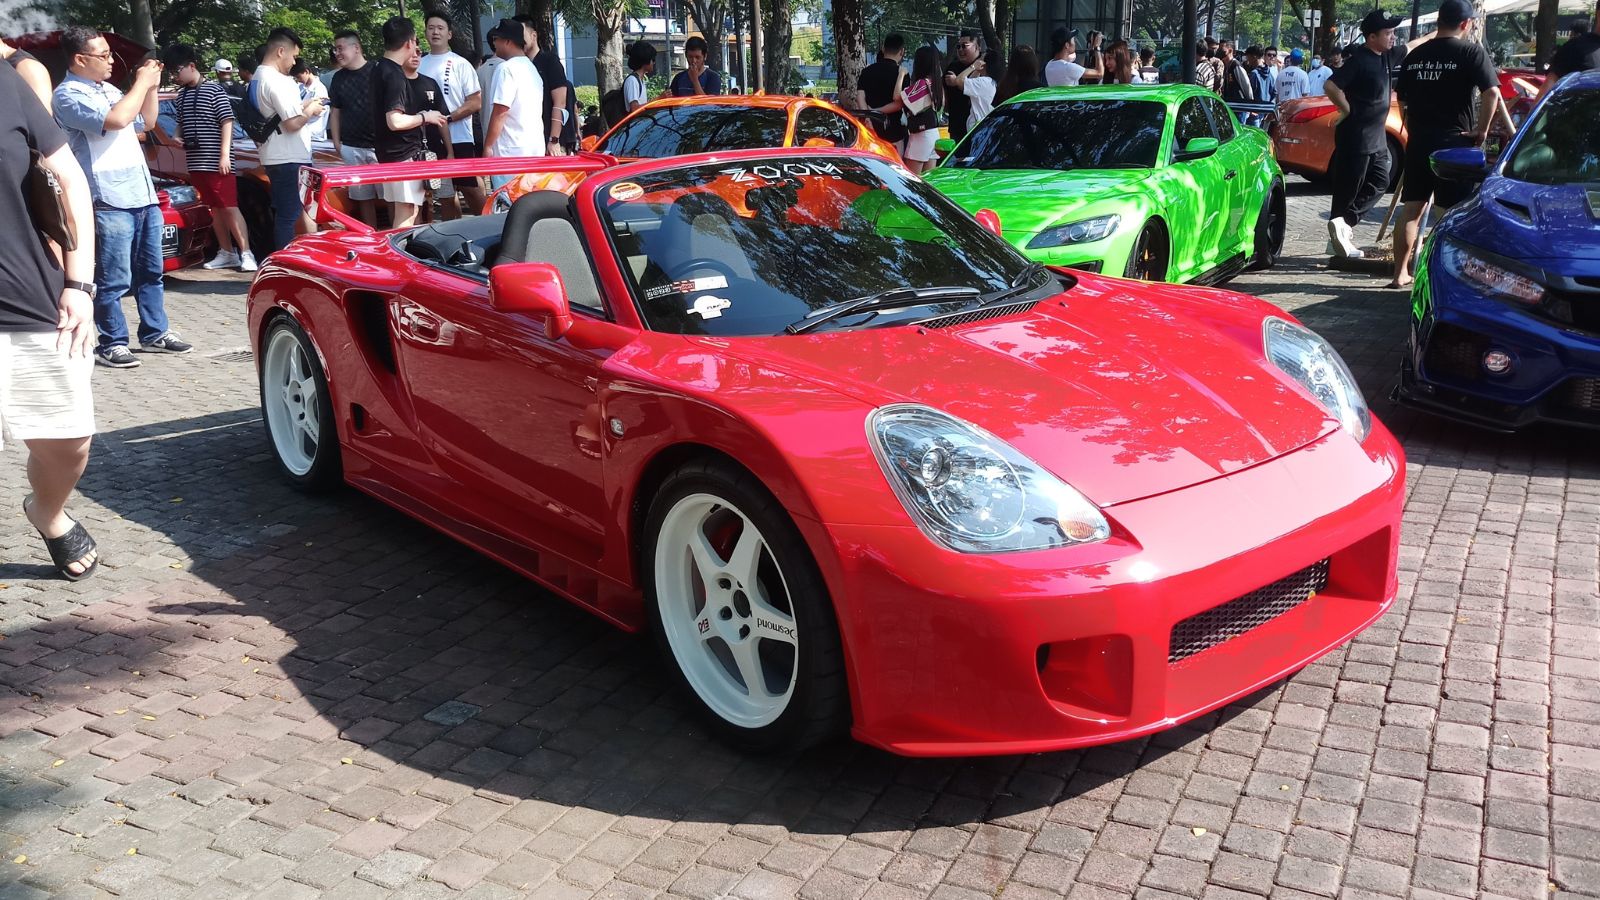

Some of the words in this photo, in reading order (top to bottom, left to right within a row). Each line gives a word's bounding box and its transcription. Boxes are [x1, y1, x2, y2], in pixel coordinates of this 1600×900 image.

[1425, 61, 1434, 70] de
[1444, 61, 1457, 70] vie
[1416, 70, 1442, 81] ADLV
[719, 162, 843, 183] ZOOM
